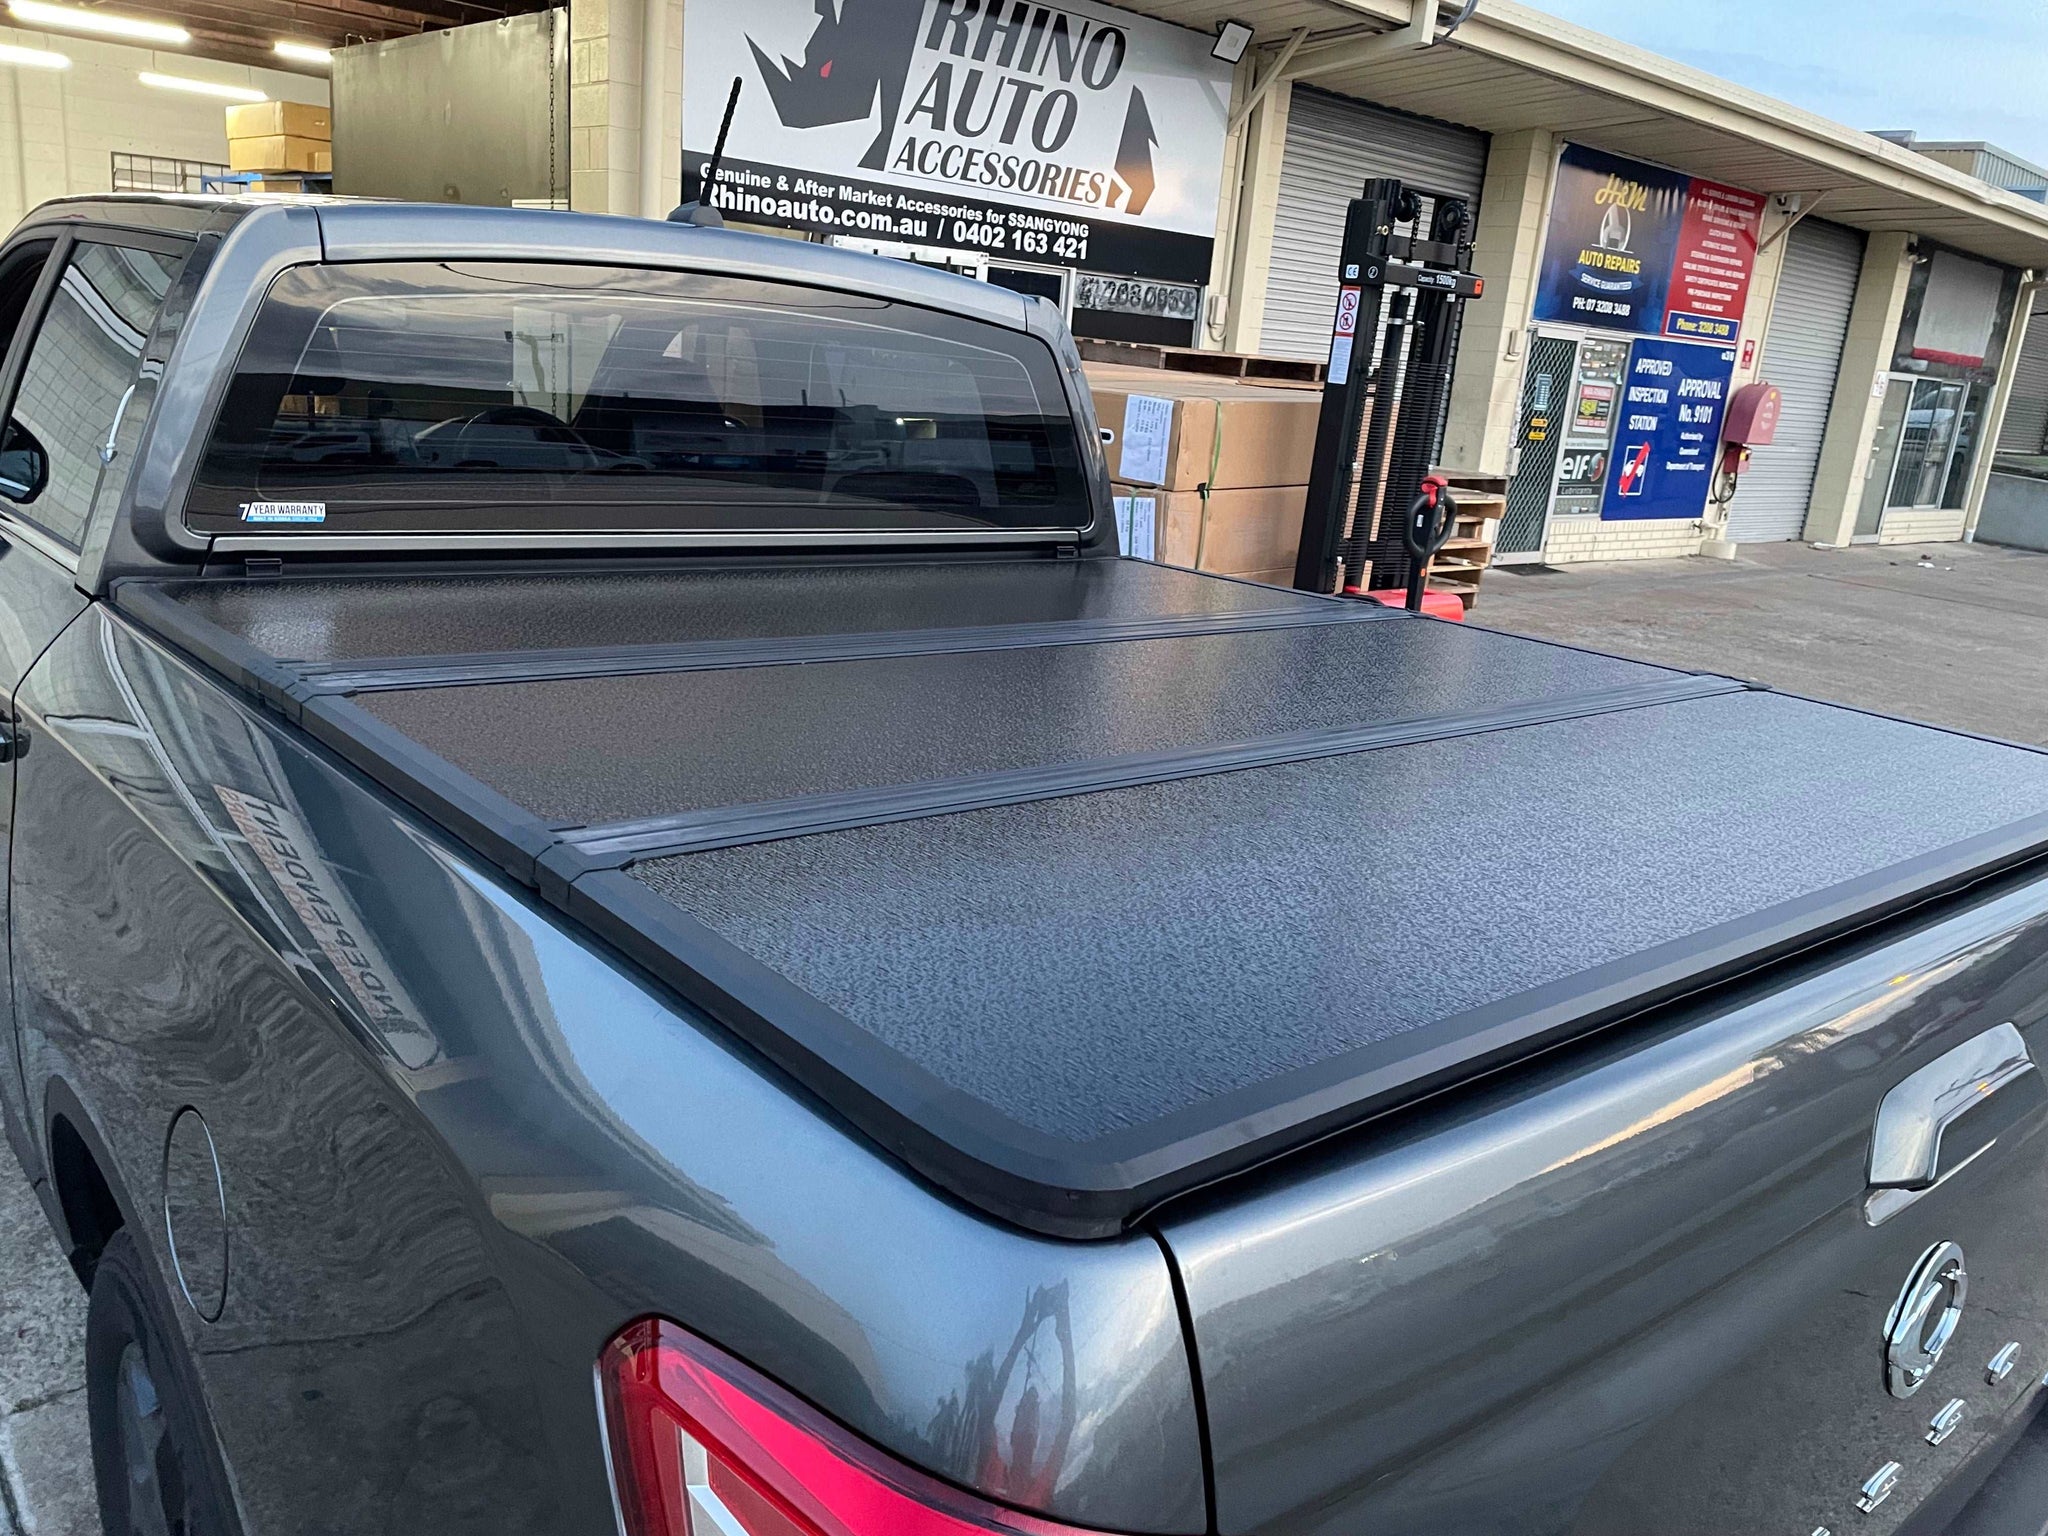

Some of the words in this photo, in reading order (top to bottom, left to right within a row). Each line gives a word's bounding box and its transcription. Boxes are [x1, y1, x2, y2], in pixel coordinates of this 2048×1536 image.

[924, 0, 1127, 91] RHINO
[904, 61, 1079, 153] AUTO
[893, 136, 1105, 204] ACCESSORIES
[776, 174, 789, 192] &
[794, 178, 835, 199] After
[838, 185, 893, 208] Market
[896, 195, 983, 222] Accessories
[986, 209, 1005, 225] for
[1008, 212, 1089, 238] SSANGYONG
[936, 218, 945, 240] /
[953, 220, 1006, 249] 0402
[1012, 230, 1048, 255] 163
[1053, 236, 1088, 260] 421
[1578, 250, 1603, 268] AUTO
[1604, 254, 1641, 275] REPAIRS
[1635, 357, 1673, 377] APPROVED
[1628, 386, 1669, 404] INSPECTION
[1677, 378, 1722, 400] APPROVAL
[1628, 414, 1658, 431] STATION
[1678, 404, 1693, 424] No.
[1693, 404, 1713, 425] 9101
[1558, 454, 1591, 481] elf
[239, 503, 251, 521] 7
[253, 505, 276, 515] YEAR
[278, 505, 324, 515] WARRANTY
